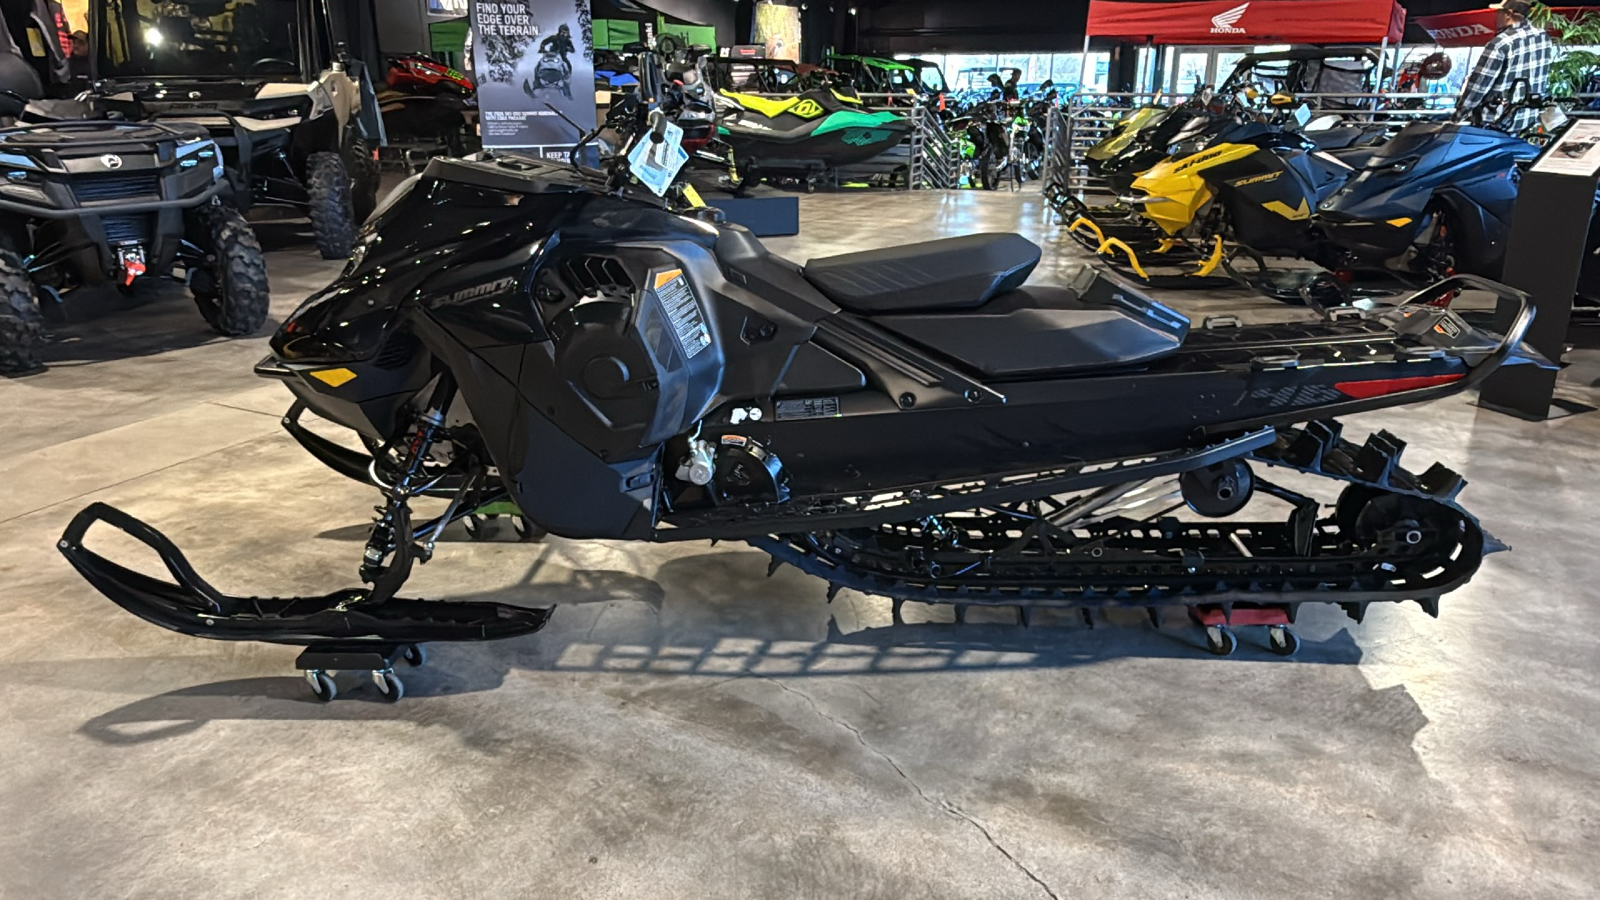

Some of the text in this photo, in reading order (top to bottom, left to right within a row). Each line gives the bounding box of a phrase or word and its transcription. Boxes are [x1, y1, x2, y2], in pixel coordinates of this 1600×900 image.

[476, 3, 498, 13] FIND
[501, 4, 526, 14] YOUR
[477, 14, 529, 25] EDGE OVER
[478, 25, 541, 35] THE TERRAIN.
